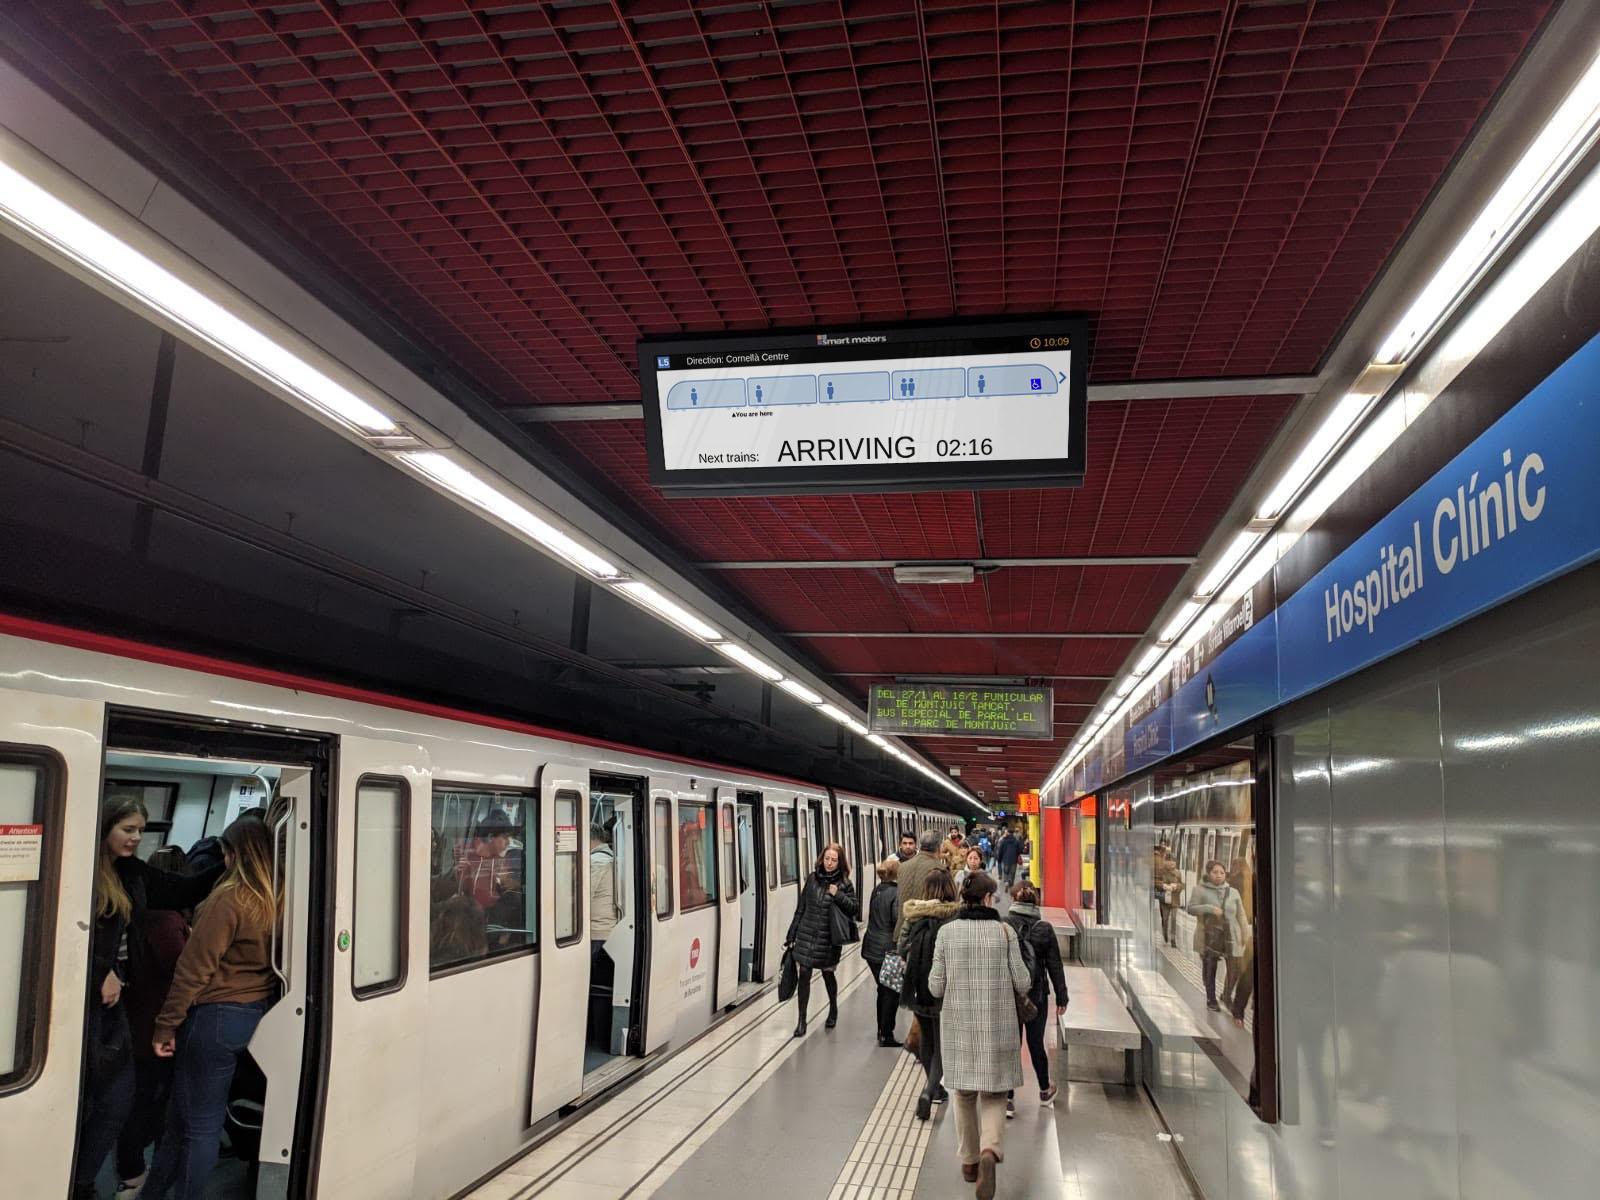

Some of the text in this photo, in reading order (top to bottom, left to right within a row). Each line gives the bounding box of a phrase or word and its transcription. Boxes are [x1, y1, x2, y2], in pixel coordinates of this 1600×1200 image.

[851, 334, 887, 344] motors
[1043, 337, 1070, 348] 10:09
[658, 358, 670, 367] L5
[686, 352, 789, 366] Direction: Cornellà Centre
[698, 436, 993, 464] Next trains: ARRIVING 02:16
[1325, 448, 1546, 643] Hospital Clínic
[877, 689, 896, 699] DEL
[933, 691, 946, 700] AL
[984, 692, 1043, 702] FUNICULAR
[901, 708, 952, 719] ESPECIAL
[959, 710, 972, 720] DE
[945, 719, 960, 728] DE
